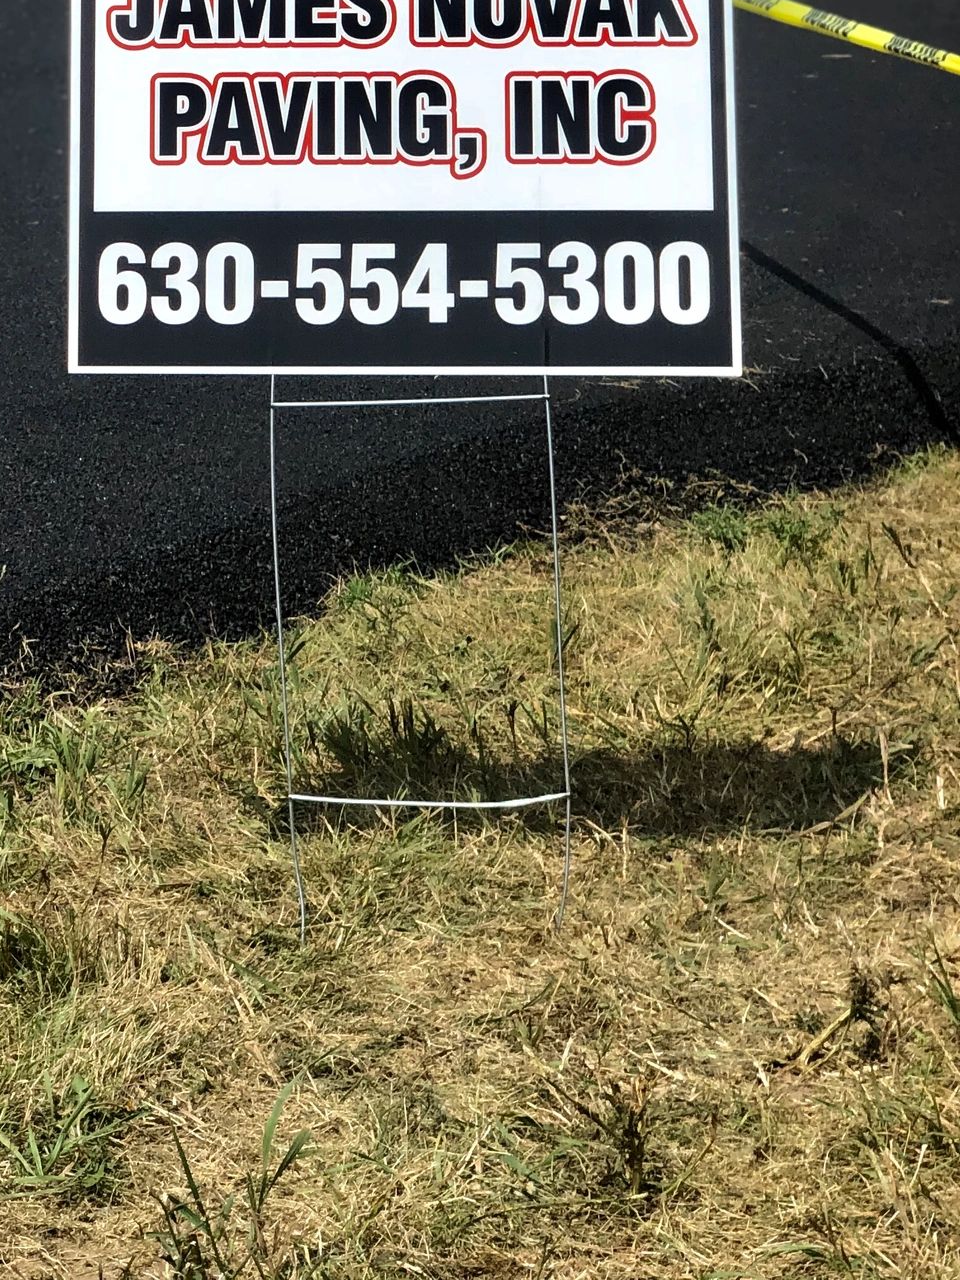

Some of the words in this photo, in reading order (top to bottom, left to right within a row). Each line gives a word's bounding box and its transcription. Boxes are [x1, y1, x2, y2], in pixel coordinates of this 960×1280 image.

[150, 70, 487, 179] PAVING,
[505, 70, 656, 165] INC
[96, 240, 712, 326] 630-554-5300
